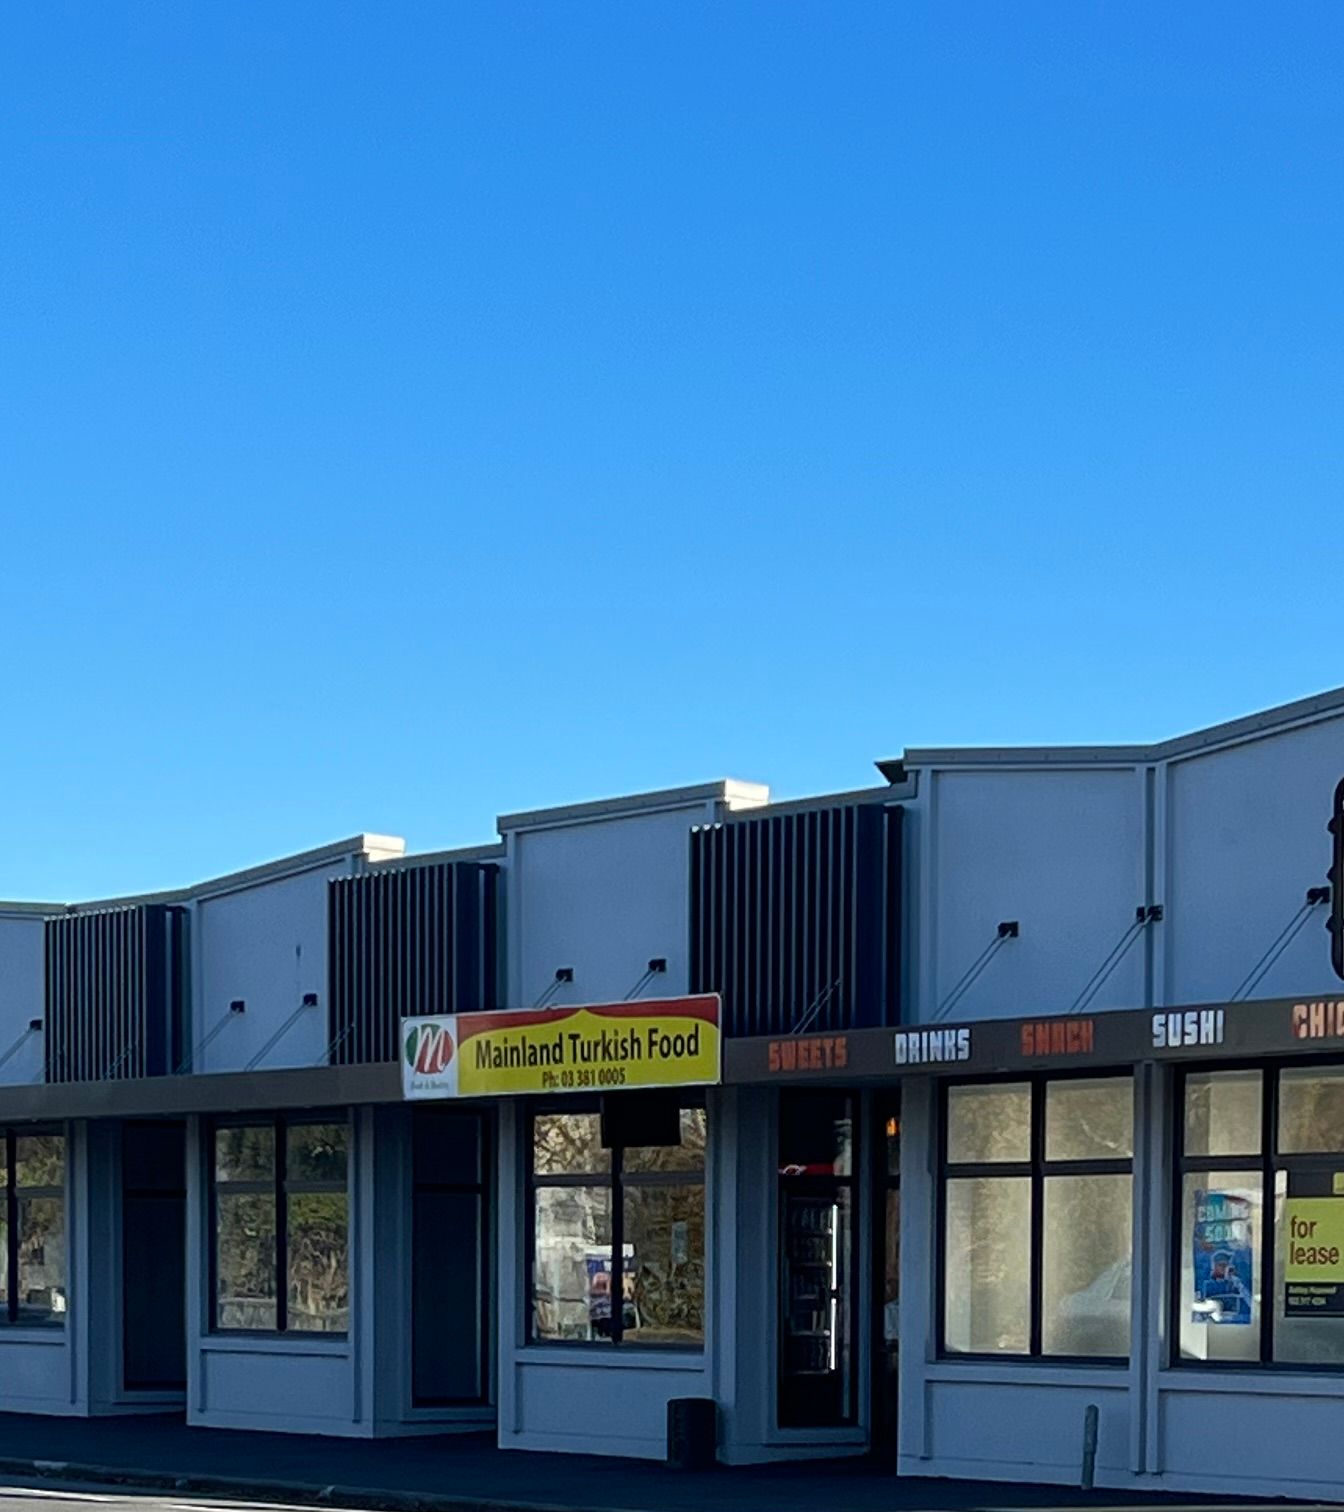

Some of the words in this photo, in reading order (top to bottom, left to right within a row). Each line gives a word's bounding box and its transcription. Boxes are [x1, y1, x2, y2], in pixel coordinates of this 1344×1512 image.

[475, 1032, 563, 1070] Mainland
[568, 1028, 641, 1064] Turkish
[648, 1023, 699, 1059] Food
[768, 1036, 847, 1072] SWEETS
[894, 1028, 971, 1065] DRINKS
[1020, 1019, 1094, 1057] SNACK
[1152, 1008, 1225, 1048] SUSHI
[542, 1071, 559, 1088] Ph:
[561, 1070, 575, 1086] 03
[577, 1069, 596, 1086] 381
[1289, 1215, 1318, 1239] for
[1289, 1241, 1340, 1266] lease
